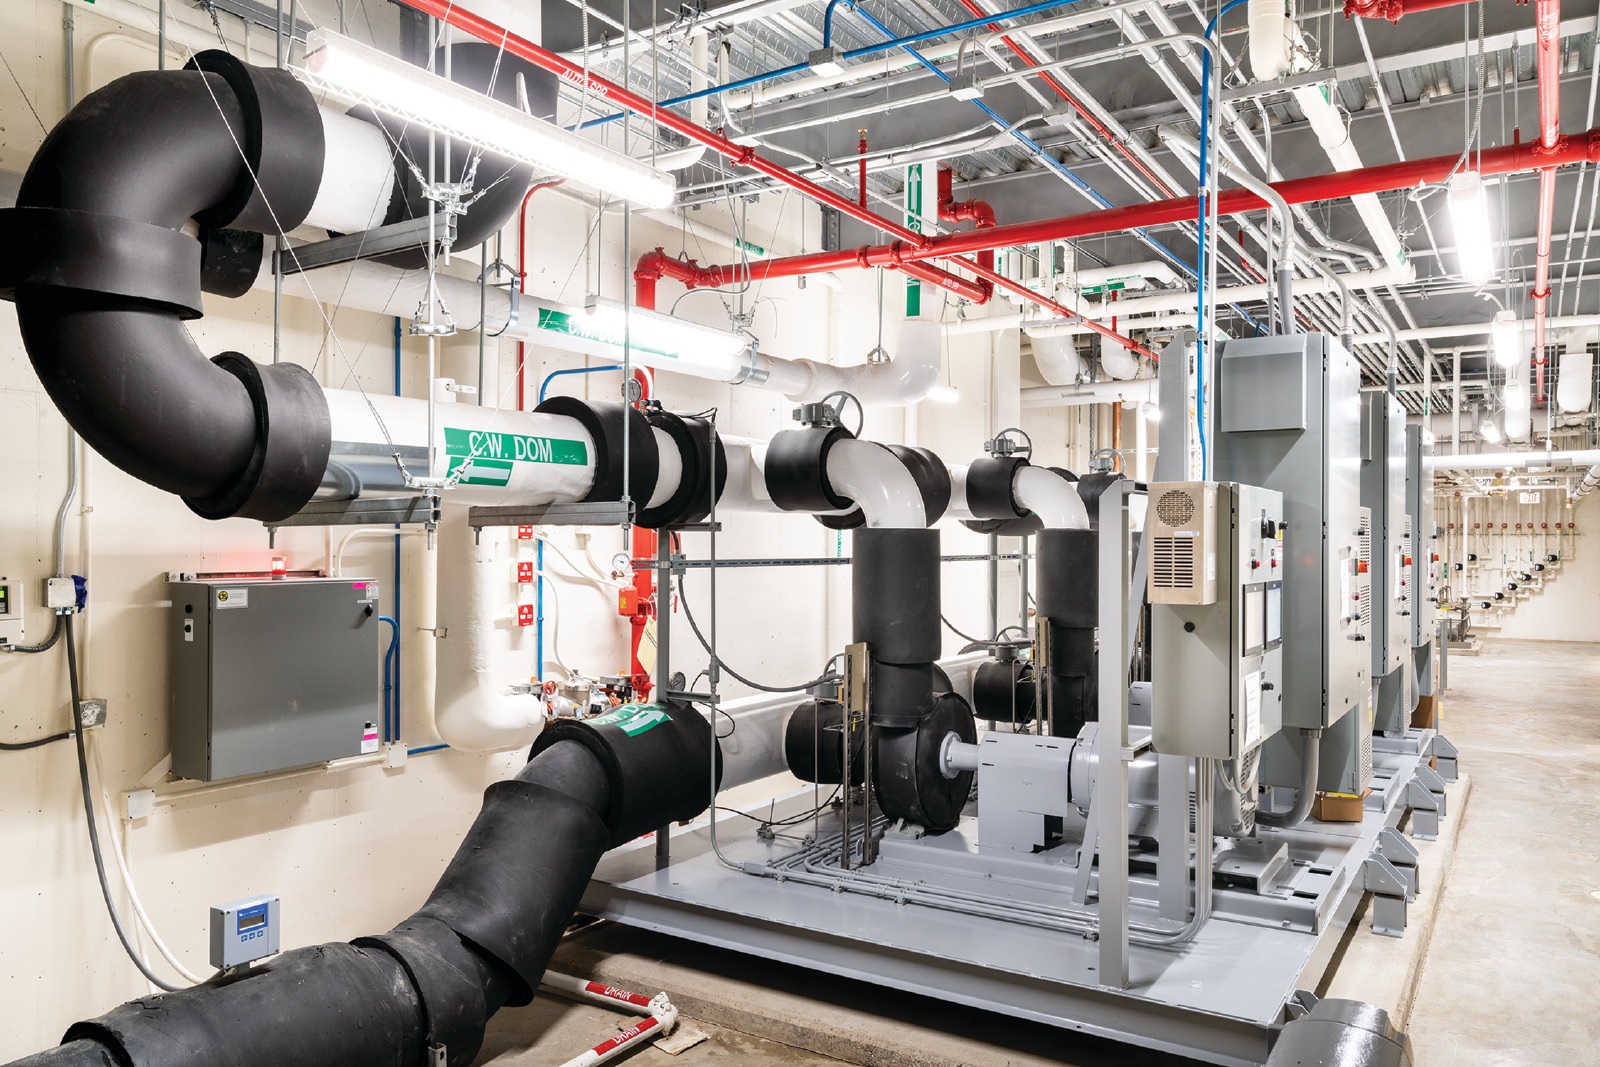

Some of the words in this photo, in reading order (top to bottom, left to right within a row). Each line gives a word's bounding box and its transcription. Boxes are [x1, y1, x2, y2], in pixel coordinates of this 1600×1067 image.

[515, 436, 553, 462] DOM
[604, 986, 632, 1000] DRAIN
[613, 1026, 640, 1044] DRAIN
